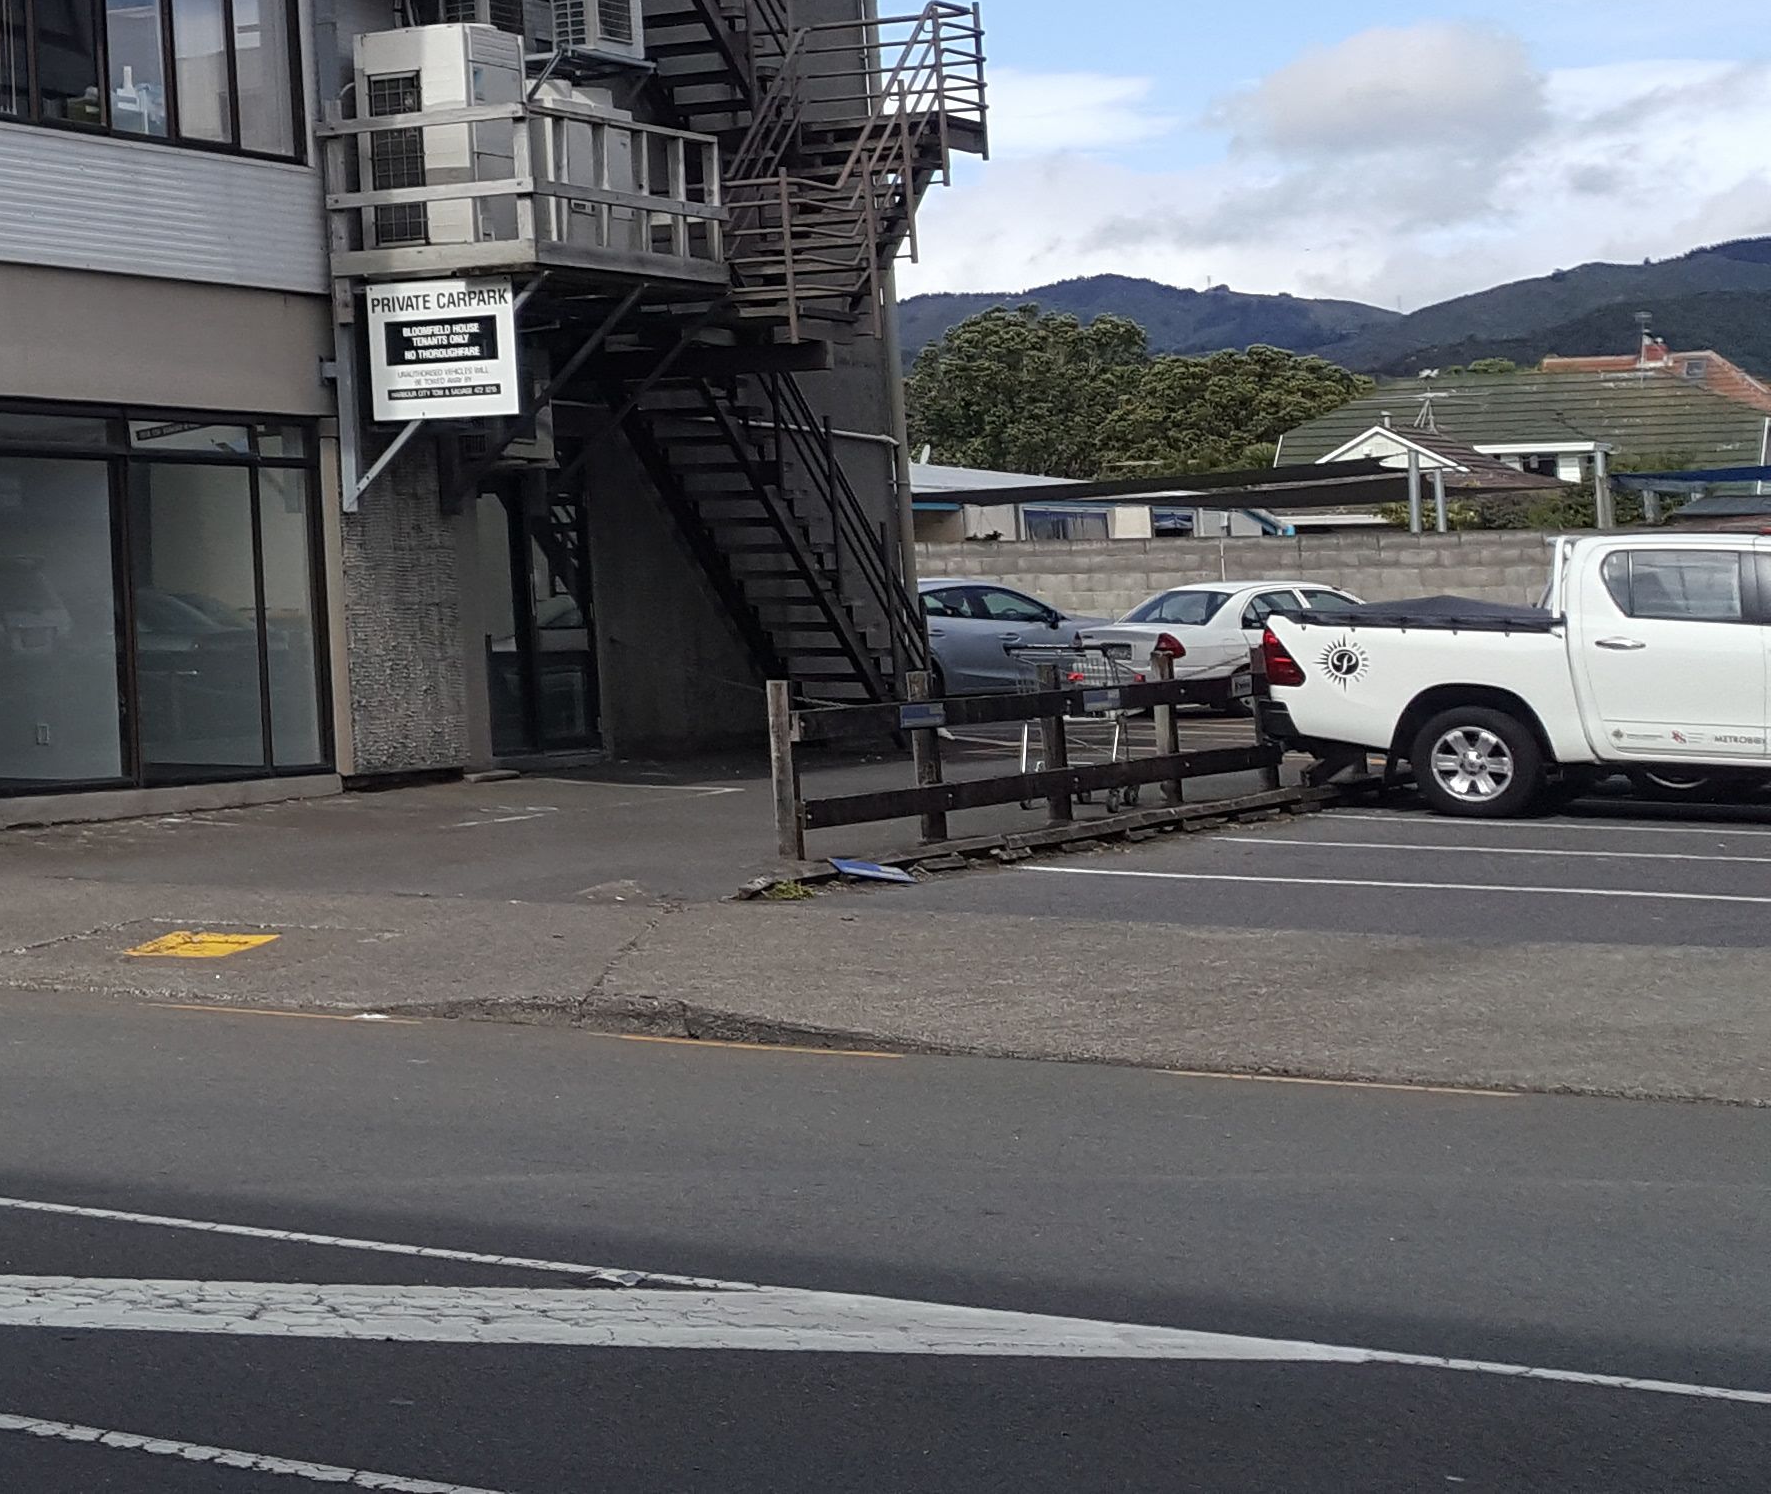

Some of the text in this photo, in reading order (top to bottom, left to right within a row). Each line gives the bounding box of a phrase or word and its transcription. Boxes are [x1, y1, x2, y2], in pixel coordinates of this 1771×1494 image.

[371, 289, 508, 313] PRIVATE CARPARK
[402, 323, 479, 337] BLOOMFIELD HOUSE
[412, 334, 469, 347] TENANTS ONLY
[405, 346, 480, 360] NO THOROUGHFARE
